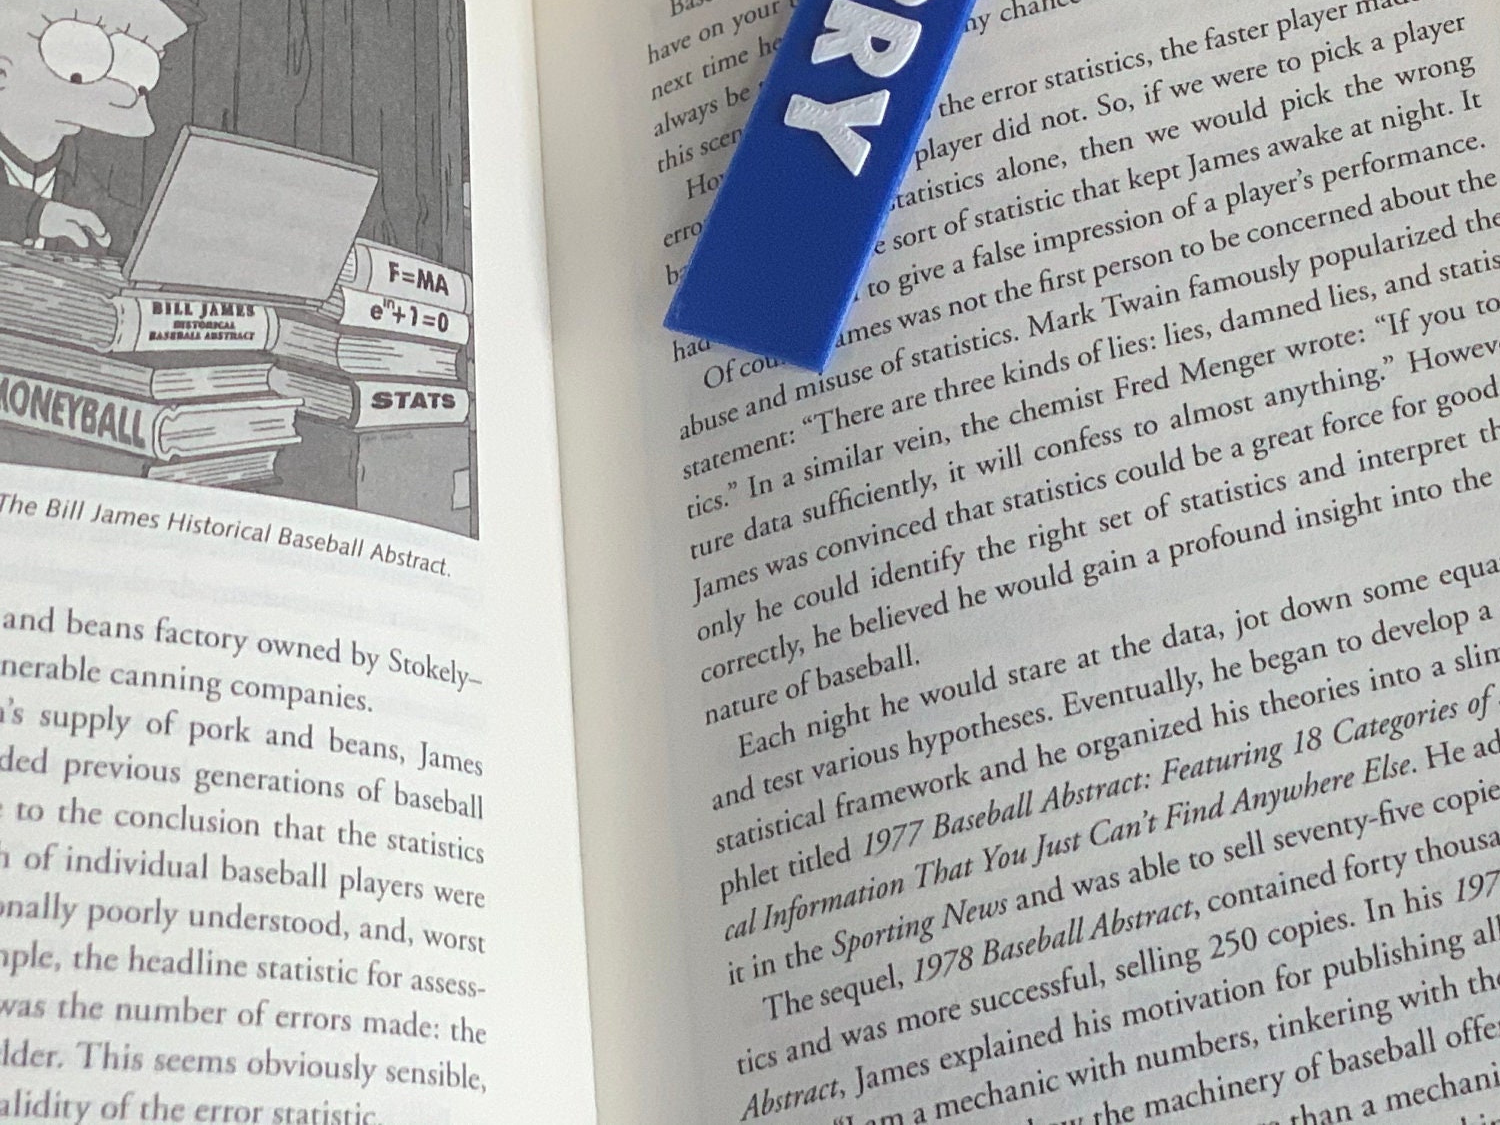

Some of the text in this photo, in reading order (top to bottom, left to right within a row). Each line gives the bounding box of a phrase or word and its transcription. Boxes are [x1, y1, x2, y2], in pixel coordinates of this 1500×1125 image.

[938, 94, 977, 118] the
[982, 79, 1037, 105] error
[1045, 50, 1152, 89] statistics,
[1160, 36, 1198, 60] the
[1204, 23, 1269, 50] faster
[1277, 4, 1348, 41] player
[152, 301, 256, 319] BILL JAMES
[388, 261, 450, 297] F=MA
[680, 407, 738, 440] abuse
[746, 382, 787, 416] and
[796, 366, 873, 400] misuse
[881, 346, 905, 375] of
[912, 326, 1019, 367] statistics.
[1027, 301, 1096, 337] Mark
[1101, 284, 1181, 317] Twain
[1189, 254, 1301, 298] famously
[1309, 214, 1458, 278] popularized
[371, 391, 456, 411] STATS
[690, 532, 734, 559] ture
[744, 514, 793, 540] data
[803, 469, 937, 523] sufficiently,
[950, 460, 965, 482] it
[976, 442, 1023, 475] will
[1034, 424, 1122, 461] confess
[1134, 419, 1158, 437] to
[1170, 395, 1254, 429] almost
[1264, 356, 1394, 408] anything.”
[46, 498, 84, 520] Bill
[90, 504, 159, 528] James
[167, 512, 271, 543] Historical
[278, 526, 364, 557] Baseball
[370, 543, 450, 577] Abstract.
[3, 605, 54, 632] and
[67, 607, 144, 640] beans
[155, 615, 248, 658] factory
[257, 637, 341, 663] owned
[352, 640, 380, 675] by
[110, 665, 372, 712] canning companies.
[706, 642, 919, 725] nature of baseball.
[40, 703, 482, 776] supply of pork and beans, James
[63, 754, 483, 819] previous generations of baseball
[721, 862, 779, 905] phlet
[789, 836, 851, 877] titled
[864, 819, 924, 856] 1977
[932, 789, 1032, 839] Baseball
[1039, 771, 1150, 813] Abstract:
[1161, 741, 1283, 785] Featuring
[1294, 726, 1322, 754] 18
[1334, 698, 1458, 744] Categories
[1468, 682, 1495, 721] of
[17, 802, 44, 821] to
[58, 796, 102, 824] the
[115, 803, 259, 836] conclusion
[274, 812, 325, 842] that
[338, 819, 376, 847] the
[387, 831, 484, 863] statistics
[24, 842, 58, 871] of
[66, 846, 207, 879] individual
[222, 854, 326, 889] baseball
[340, 865, 423, 901] players
[434, 885, 485, 908] were
[729, 961, 744, 985] it
[753, 954, 776, 979] in
[785, 940, 823, 969] the
[832, 914, 935, 963] Sporting
[942, 897, 1007, 929] News
[1016, 874, 1065, 911] and
[1071, 871, 1120, 896] was
[1128, 851, 1180, 884] able
[1189, 850, 1214, 870] to
[1224, 828, 1265, 862] sell
[1273, 798, 1424, 851] seventy-five
[87, 896, 485, 954] poorly understood, and, worst
[74, 942, 118, 971] the
[128, 944, 247, 977] headline
[257, 956, 357, 985] statistic
[367, 959, 402, 988] for
[58, 990, 103, 1019] the
[115, 994, 227, 1024] number
[238, 999, 269, 1026] of
[276, 1011, 351, 1031] errors
[363, 1009, 438, 1038] made:
[451, 1015, 486, 1044] the
[740, 1078, 845, 1121] Abstract,
[855, 1058, 929, 1099] James
[940, 1015, 1064, 1072] explained
[1072, 1008, 1111, 1038] his
[1122, 978, 1265, 1027] motivation
[1276, 963, 1312, 991] for
[1323, 932, 1465, 988] publishing
[77, 1041, 486, 1094] This seems obviously sensible,
[101, 1091, 134, 1120] of
[140, 1092, 185, 1122] the
[195, 1104, 263, 1124] error
[273, 1100, 382, 1125] statistic.
